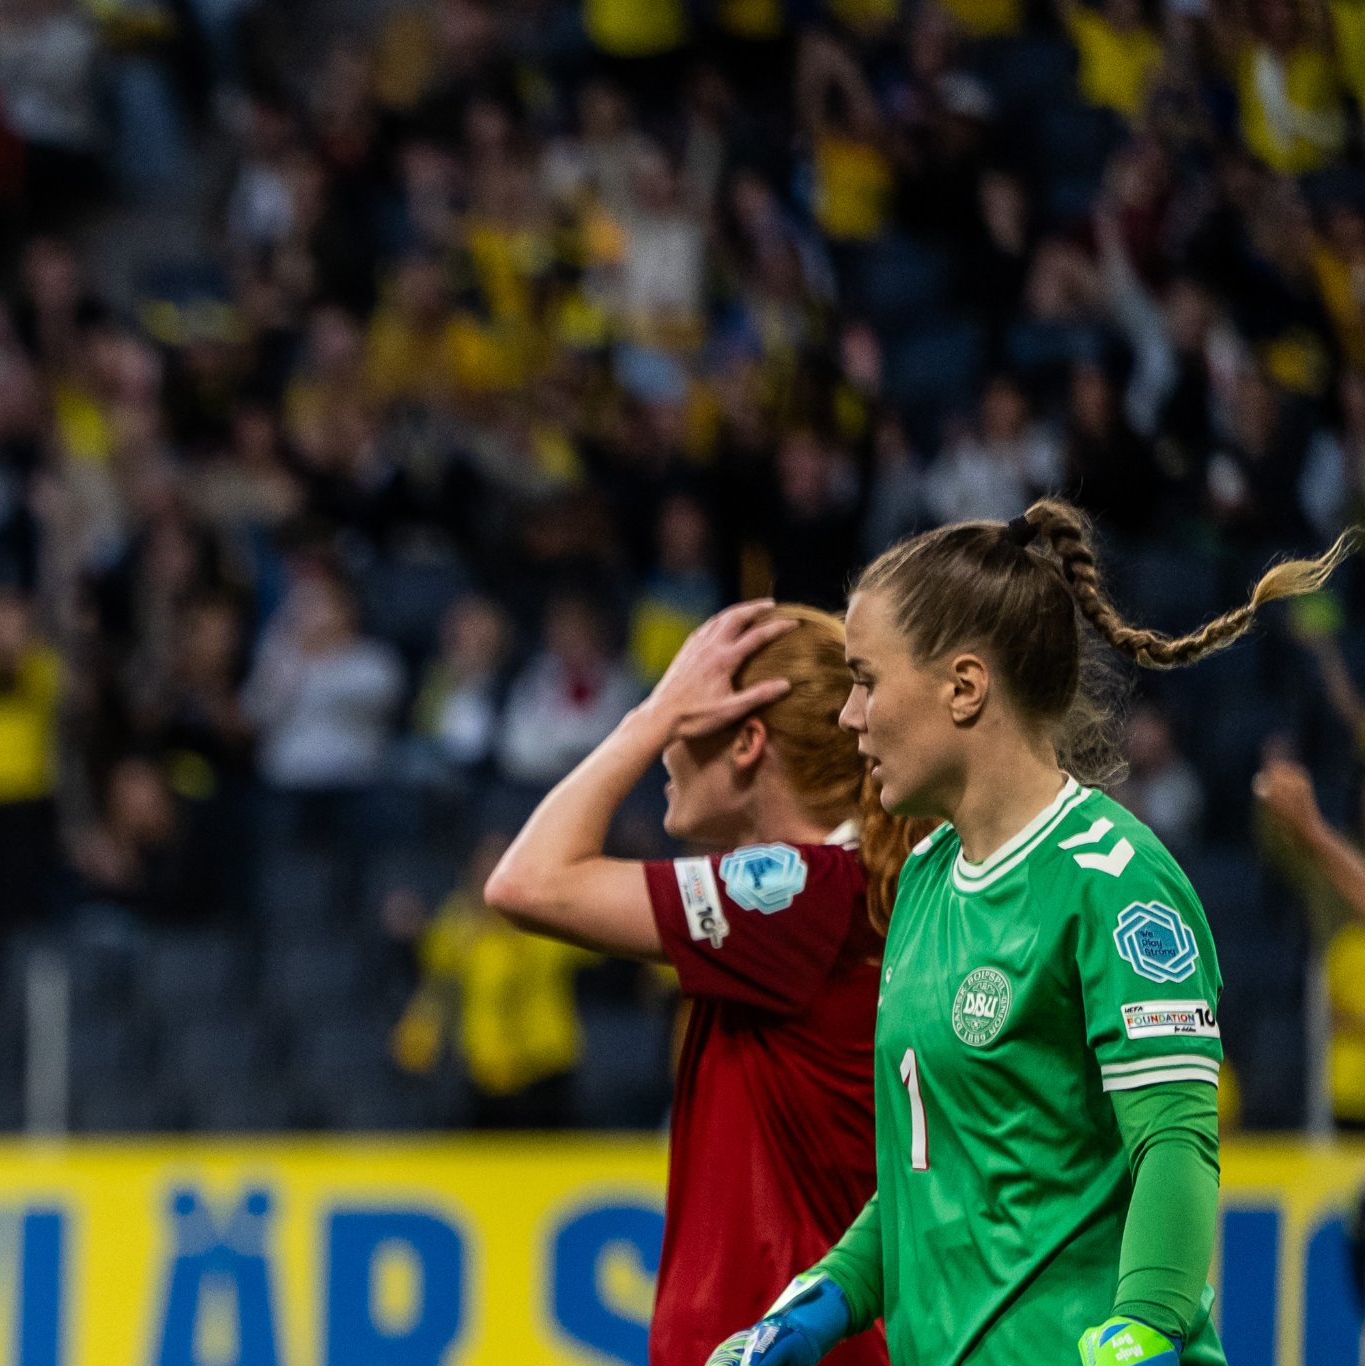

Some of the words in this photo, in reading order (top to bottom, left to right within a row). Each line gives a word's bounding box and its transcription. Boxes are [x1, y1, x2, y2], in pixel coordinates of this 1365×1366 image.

[1142, 939, 1162, 948] Play
[1144, 948, 1177, 957] Strong
[963, 991, 998, 1018] DBU
[1127, 1014, 1196, 1025] FOUNDATION
[900, 1047, 930, 1171] 1
